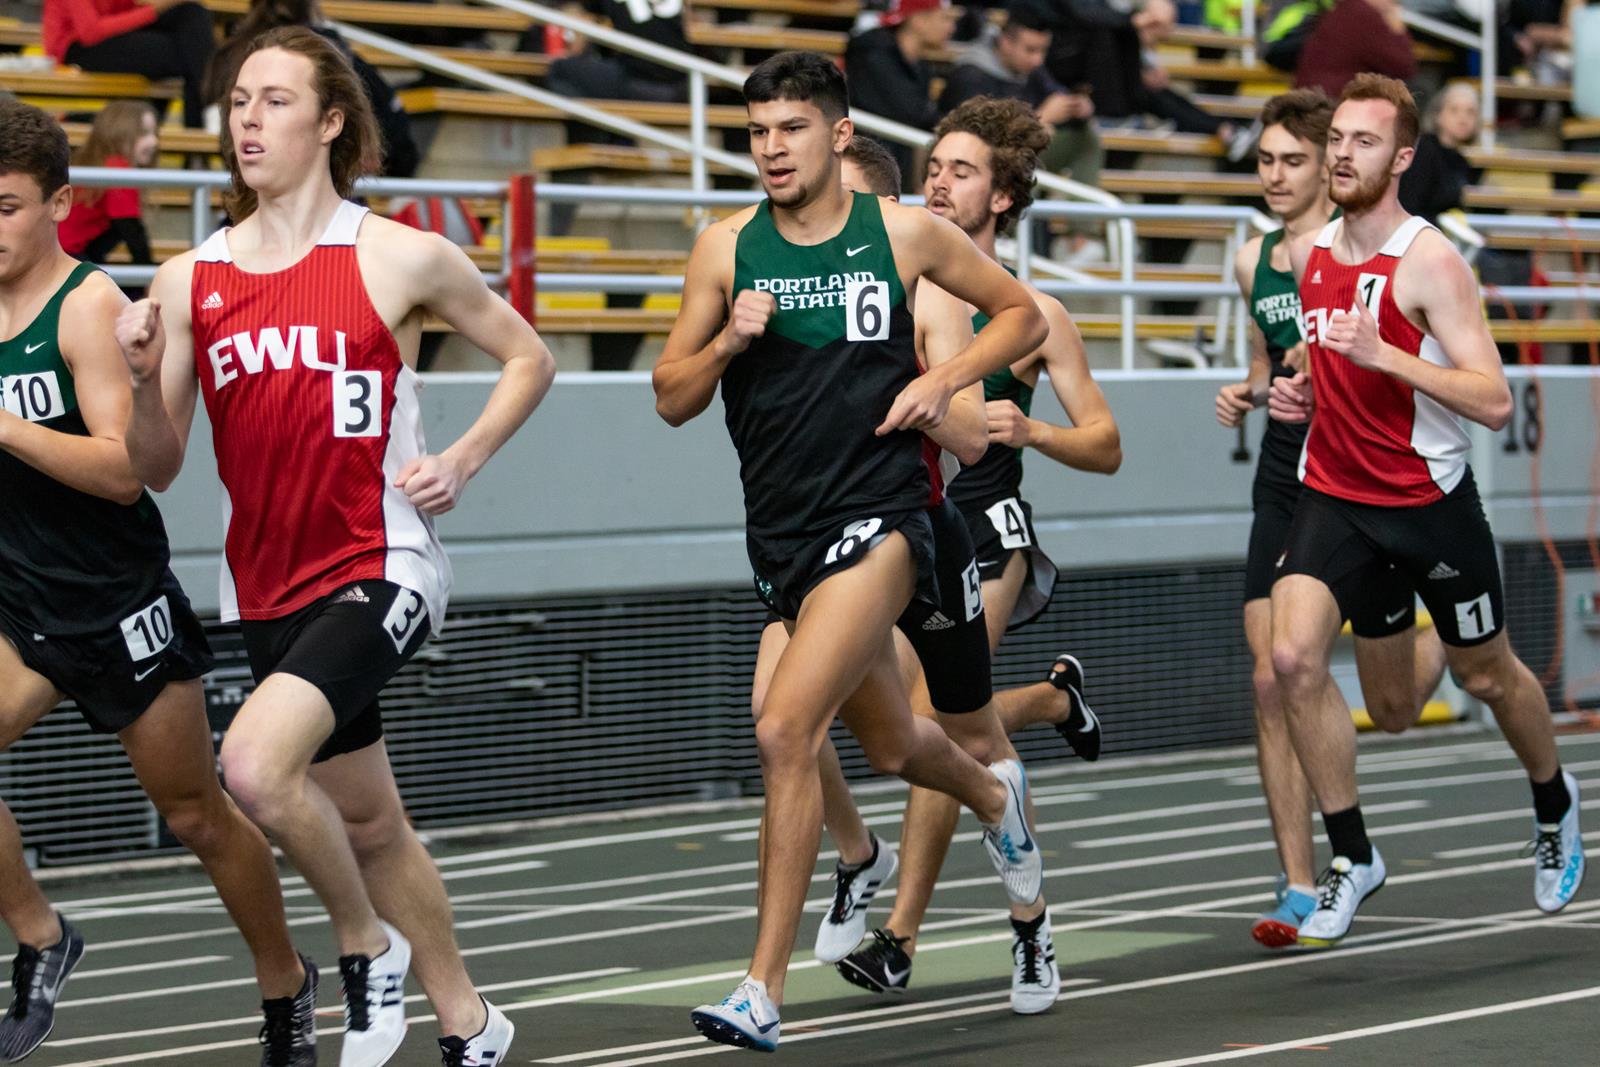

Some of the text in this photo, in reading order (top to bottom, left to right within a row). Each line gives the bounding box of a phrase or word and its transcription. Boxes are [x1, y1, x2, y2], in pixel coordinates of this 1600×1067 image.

[856, 285, 882, 338] 6
[1256, 292, 1301, 315] PORTL
[1364, 278, 1377, 308] 1
[207, 325, 347, 391] EWU
[12, 376, 52, 419] 10
[344, 374, 372, 434] 3
[1004, 503, 1026, 543] 4
[968, 566, 981, 615] 5
[133, 605, 169, 653] 10
[391, 590, 424, 641] 3
[922, 619, 956, 631] adidas
[1467, 601, 1484, 634] 1
